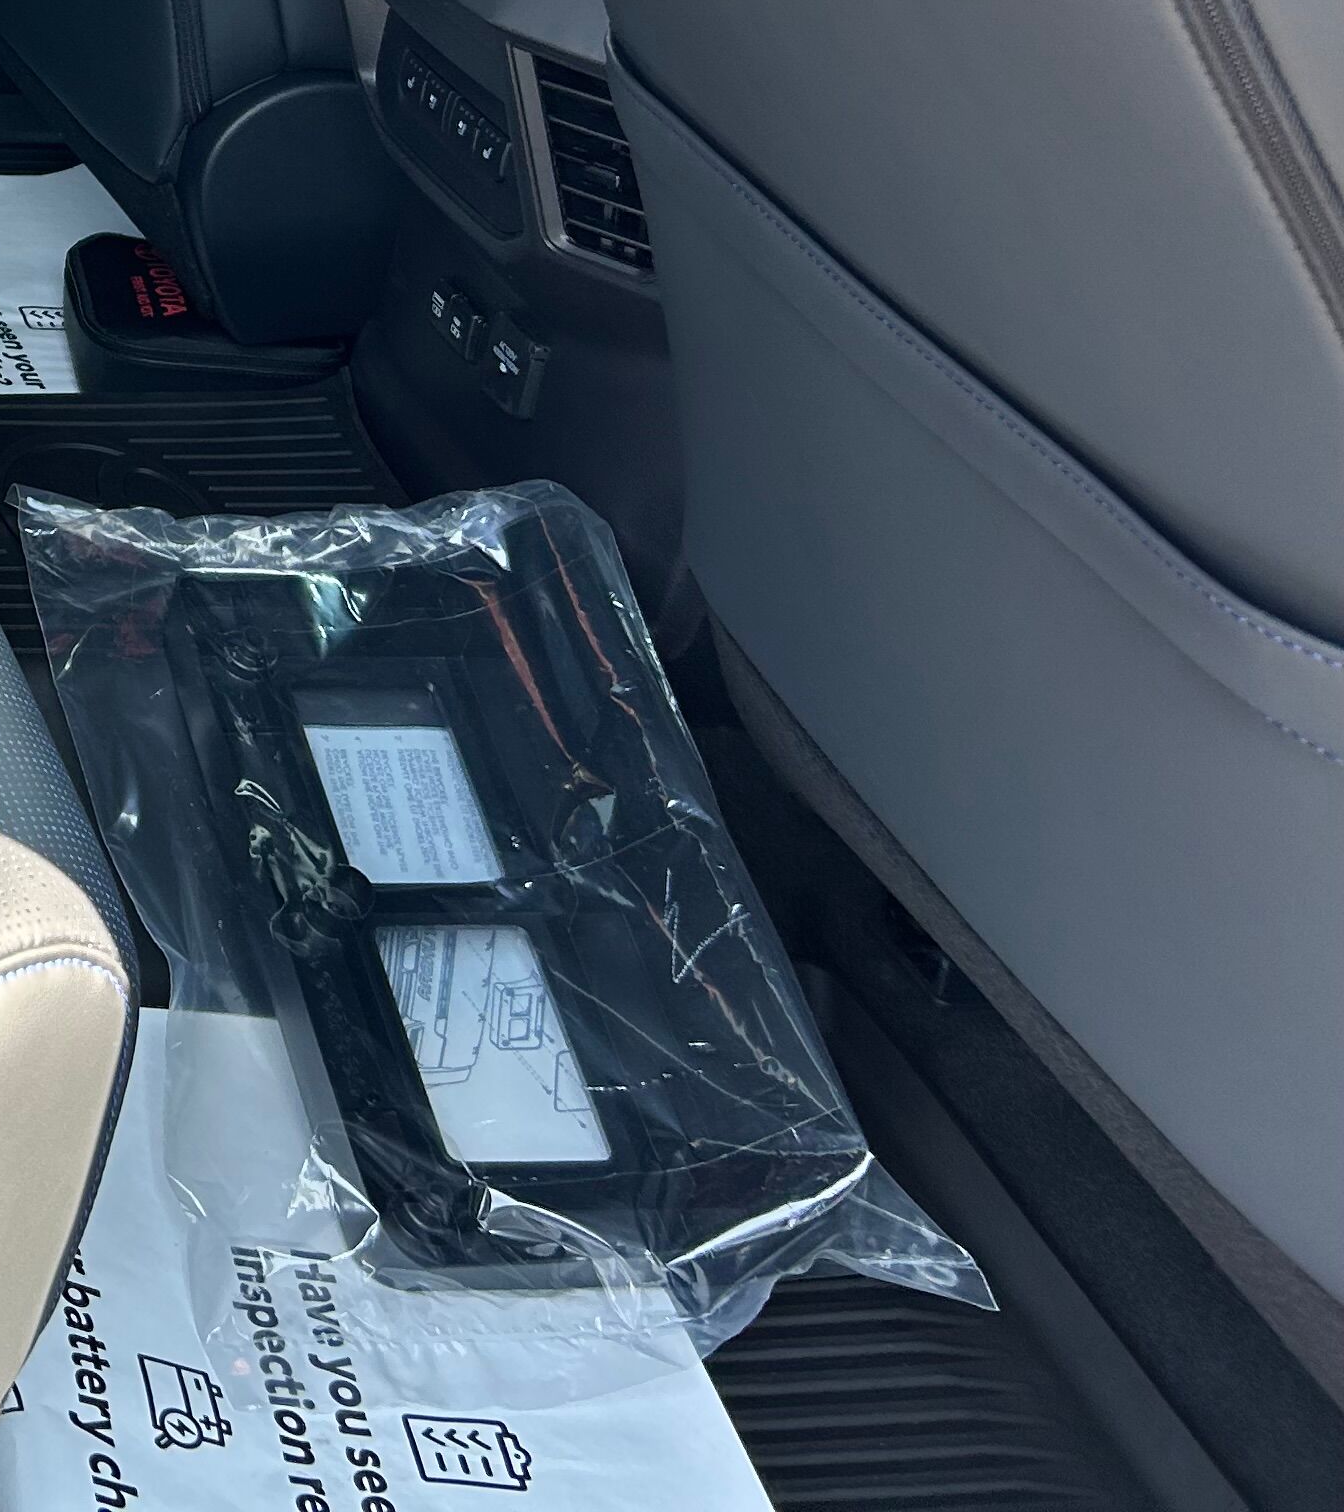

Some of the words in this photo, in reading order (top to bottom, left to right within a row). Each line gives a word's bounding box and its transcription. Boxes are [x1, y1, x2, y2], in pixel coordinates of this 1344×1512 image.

[2, 347, 46, 390] your
[289, 1248, 346, 1347] Have
[62, 1277, 117, 1449] battery
[230, 1244, 316, 1466] inspection
[307, 1348, 374, 1439] you
[88, 1451, 140, 1512] ch
